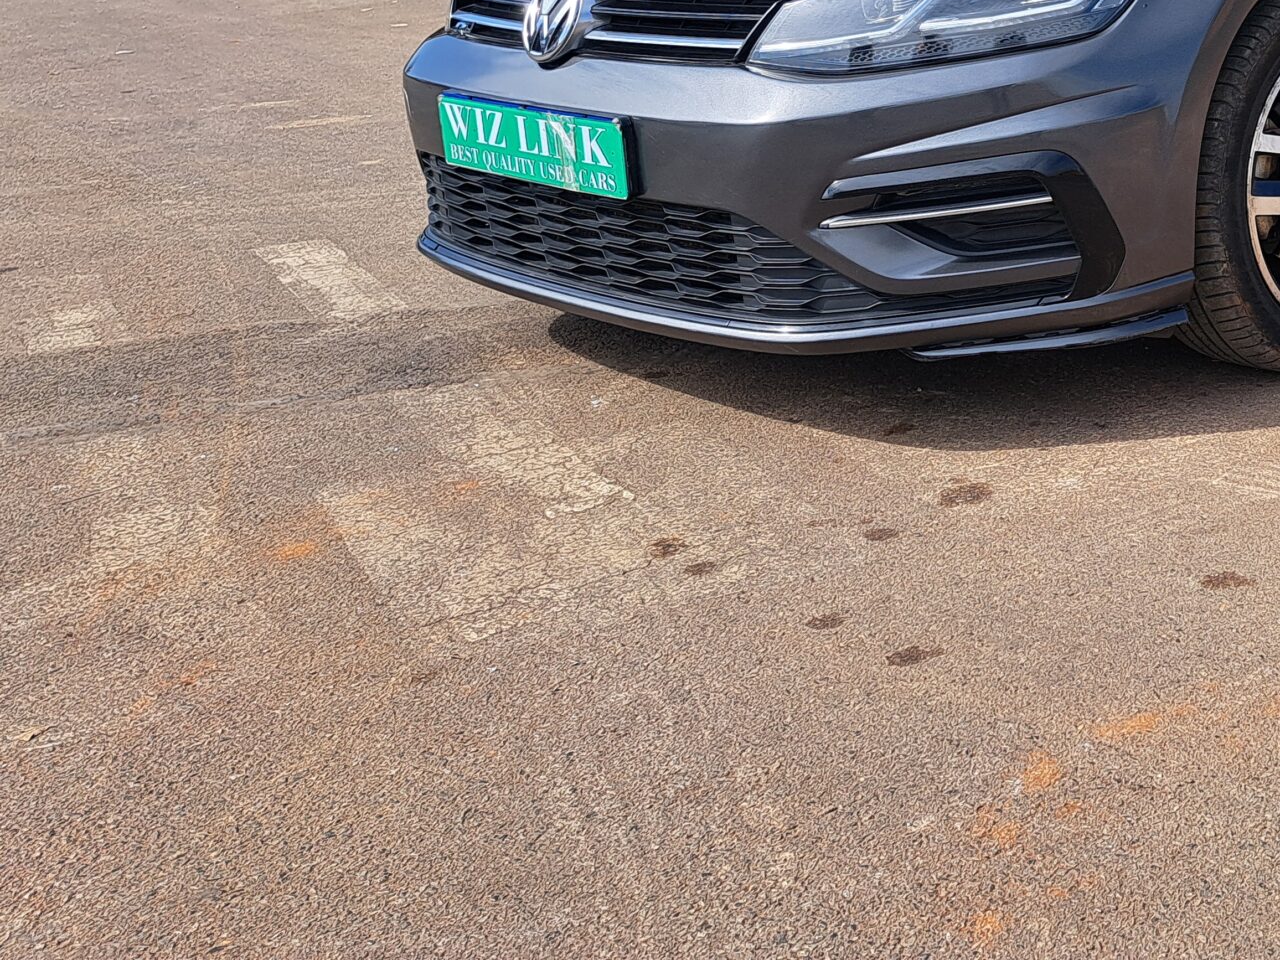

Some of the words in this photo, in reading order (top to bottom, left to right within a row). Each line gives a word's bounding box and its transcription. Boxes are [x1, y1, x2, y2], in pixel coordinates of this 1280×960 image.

[442, 102, 506, 149] WIZ
[515, 114, 613, 168] LINK
[450, 143, 479, 165] BEST
[482, 149, 536, 177] QUALITY
[540, 161, 574, 184] USED
[579, 169, 617, 192] CARS
